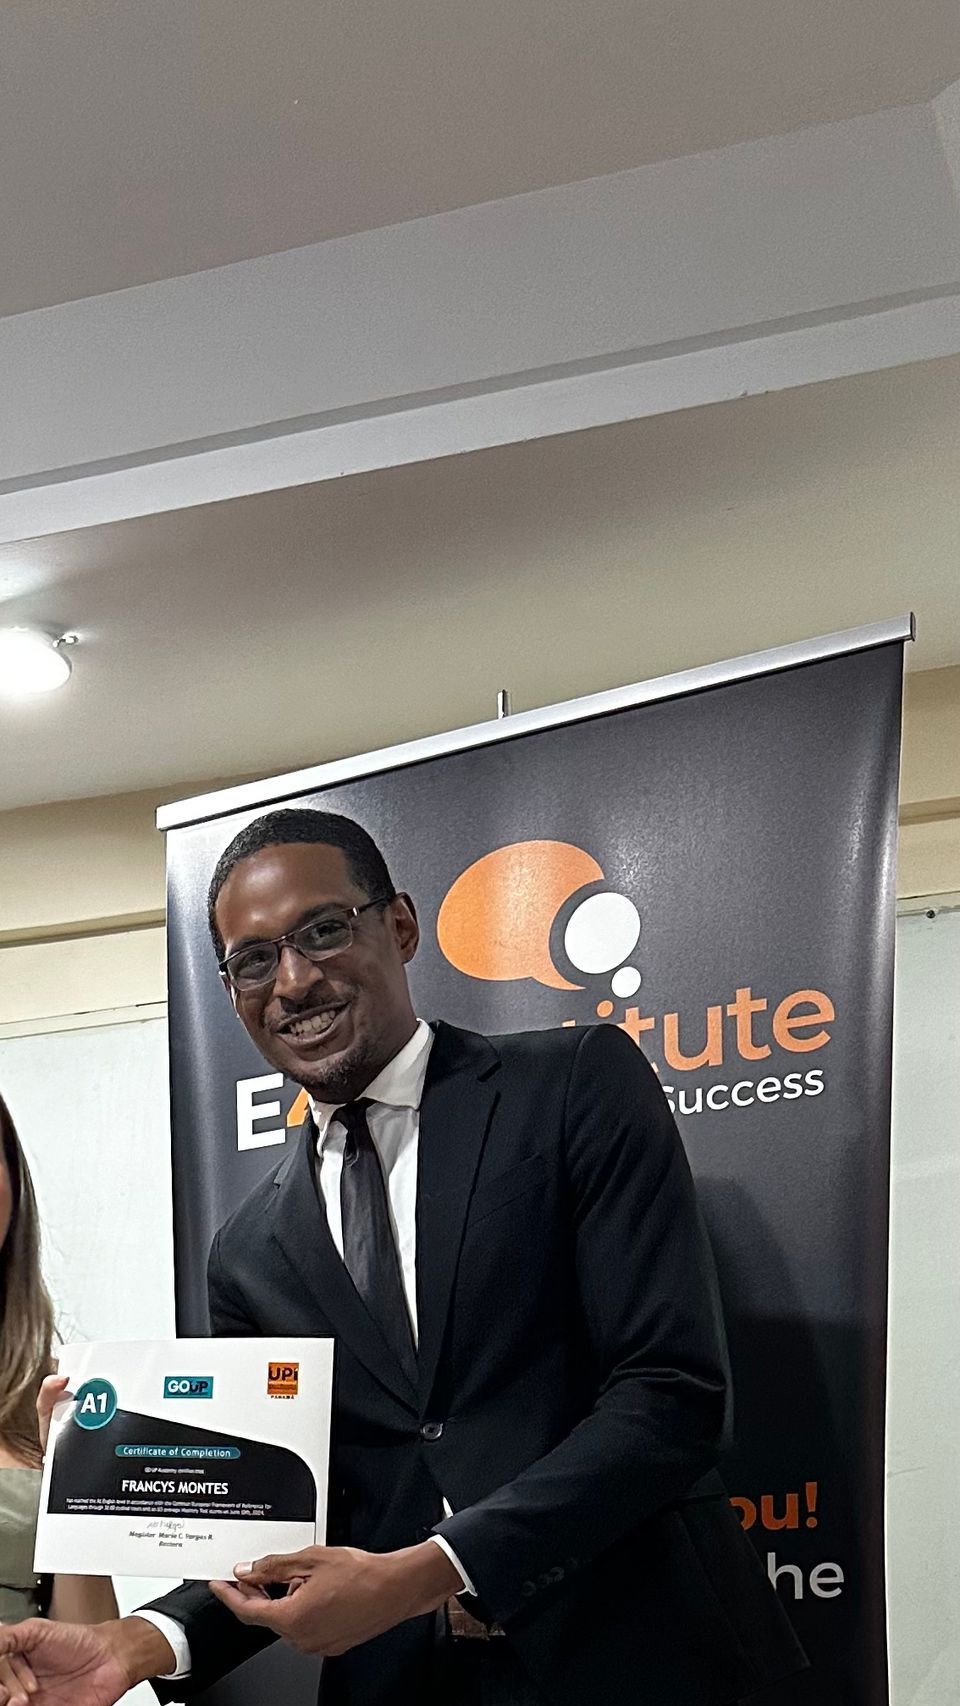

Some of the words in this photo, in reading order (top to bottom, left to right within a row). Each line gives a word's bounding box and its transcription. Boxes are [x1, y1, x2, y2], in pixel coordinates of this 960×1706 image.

[81, 1393, 107, 1413] A1
[123, 1446, 166, 1456] Certificate
[169, 1446, 178, 1456] of
[181, 1448, 230, 1459] Completion
[122, 1480, 175, 1493] FRANCYS
[177, 1482, 228, 1494] MONTES
